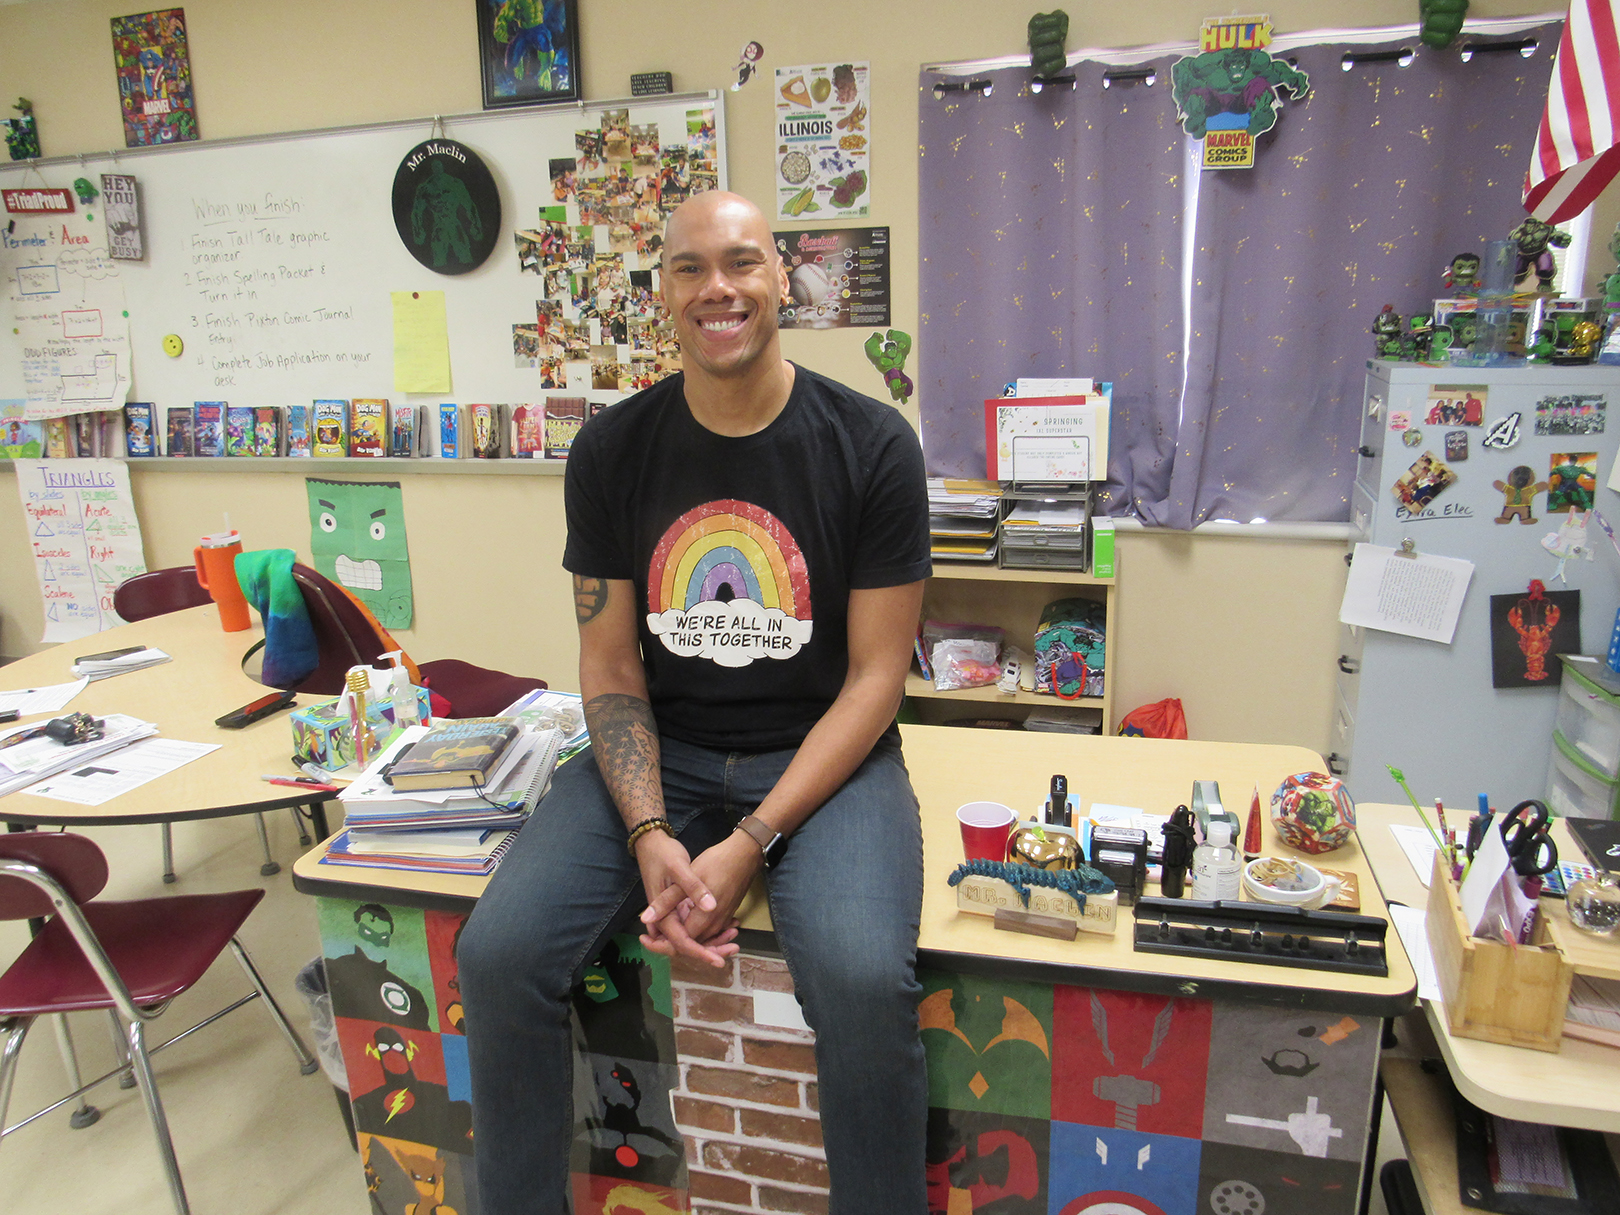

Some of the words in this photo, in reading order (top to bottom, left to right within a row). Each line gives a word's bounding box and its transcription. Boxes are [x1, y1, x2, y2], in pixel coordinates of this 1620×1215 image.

[1201, 23, 1273, 50] HULK
[142, 99, 171, 116] MARVEL
[779, 120, 833, 137] ILLINOIS
[1206, 133, 1251, 148] MARVEL
[407, 153, 426, 172] Mr.
[426, 143, 468, 164] Maclin
[1207, 147, 1248, 156] COMICS
[1207, 155, 1247, 163] GROUP
[103, 177, 133, 191] HEY
[7, 191, 68, 210] #TriadProud
[103, 191, 134, 205] YOU
[192, 198, 231, 220] When
[236, 203, 257, 222] you
[1, 227, 47, 249] Perimeter
[61, 224, 90, 245] Area
[191, 233, 224, 250] Finish
[226, 230, 254, 247] Tall
[258, 228, 284, 245] Tale
[290, 230, 331, 249] graphic
[797, 233, 839, 247] Baseball
[111, 246, 138, 257] BUSY
[196, 270, 229, 286] Finish
[234, 268, 276, 287] Spelling
[278, 265, 314, 279] Packet
[199, 290, 228, 303] Turn
[233, 287, 243, 299] it
[248, 290, 258, 300] in
[205, 313, 241, 329] Finish
[283, 311, 312, 325] Comic
[313, 306, 354, 322] Journal
[24, 347, 41, 358] ODD
[42, 347, 77, 357] FIGURES
[212, 354, 252, 373] Complete
[255, 352, 274, 370] Job
[277, 350, 331, 371] Application
[335, 351, 349, 363] on
[350, 351, 372, 369] your
[214, 374, 237, 387] desk
[1043, 418, 1083, 426] SPRINGING
[37, 467, 115, 487] TRIANGLES
[26, 503, 67, 520] Equilateral
[85, 504, 113, 517] Acute
[1443, 503, 1474, 516] Elec
[90, 545, 114, 562] Right
[44, 585, 75, 598] Scalene
[676, 615, 726, 630] WE'RE
[730, 616, 761, 631] ALL
[767, 618, 783, 632] IN
[670, 632, 703, 647] THIS
[710, 633, 793, 650] TOGETHER
[445, 723, 499, 733] AGAIN
[962, 884, 1006, 906] MR.
